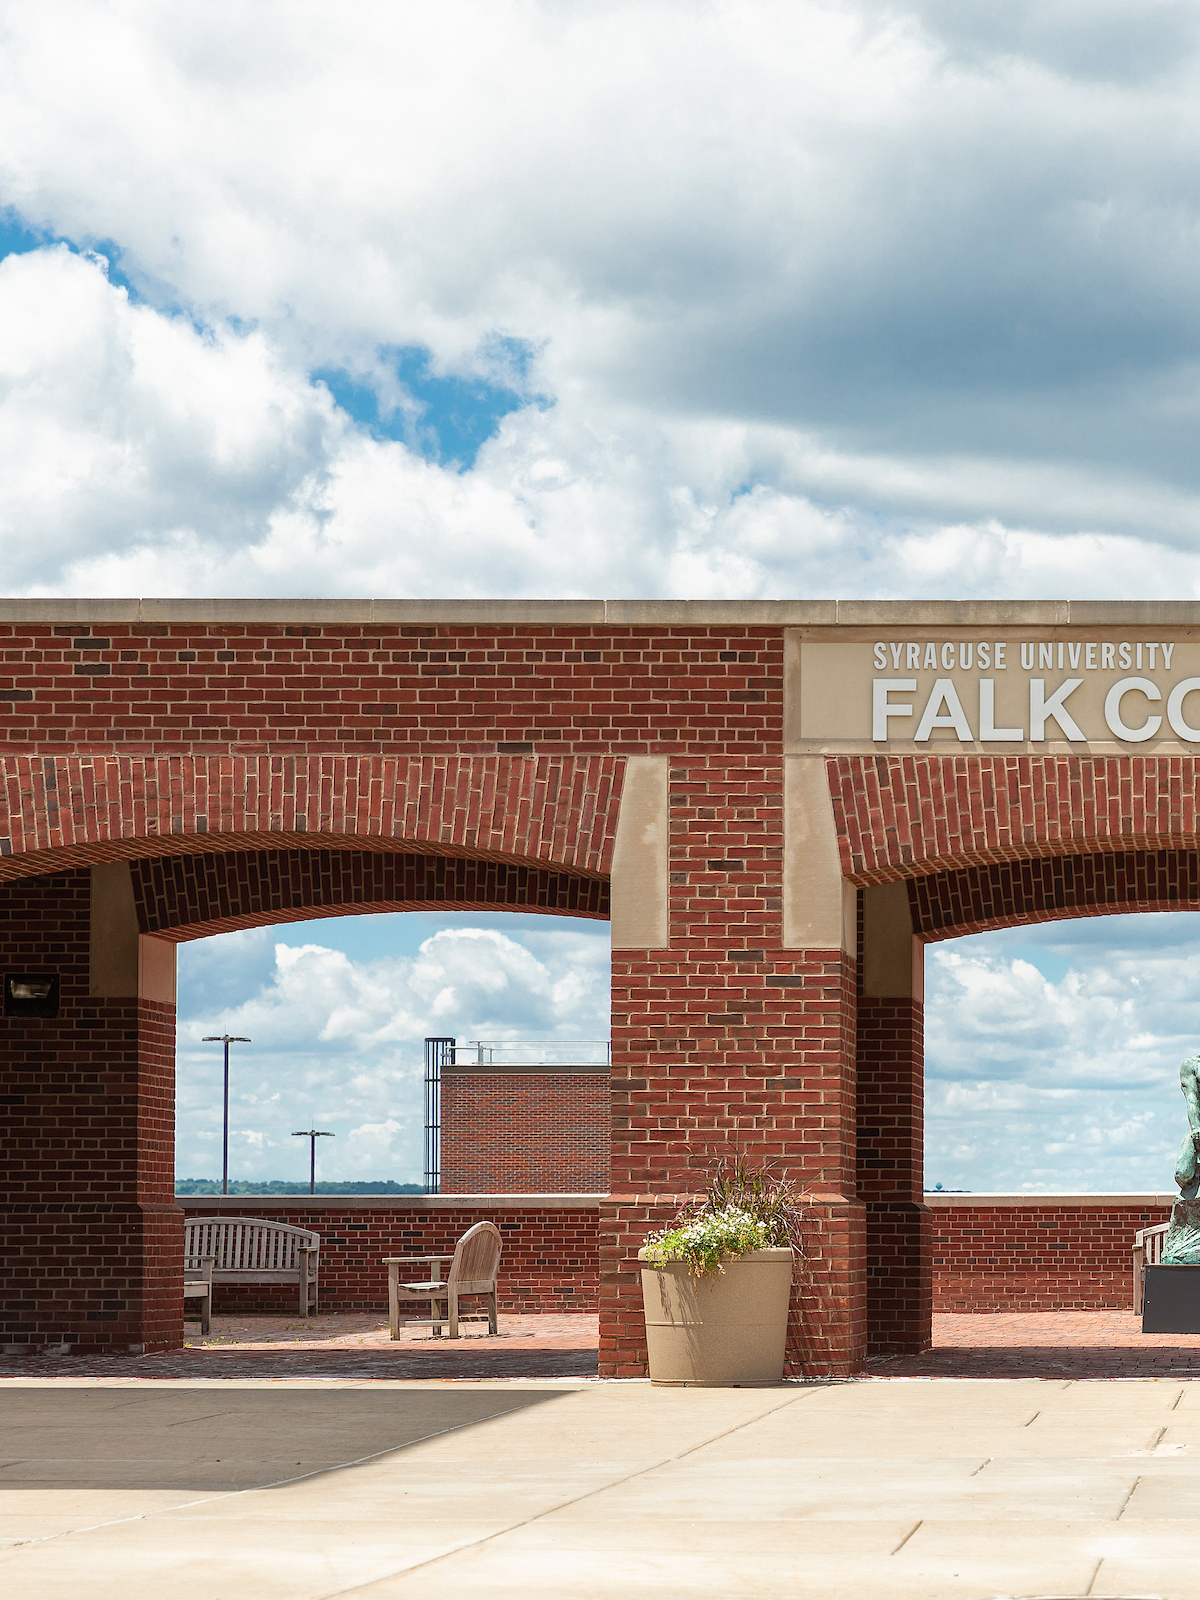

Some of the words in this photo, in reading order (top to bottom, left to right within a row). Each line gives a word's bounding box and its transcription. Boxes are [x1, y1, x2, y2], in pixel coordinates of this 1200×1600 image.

[873, 641, 1007, 670] SYRACUSE
[1020, 641, 1175, 670] UNIVERSITY
[872, 678, 1085, 741] FALK
